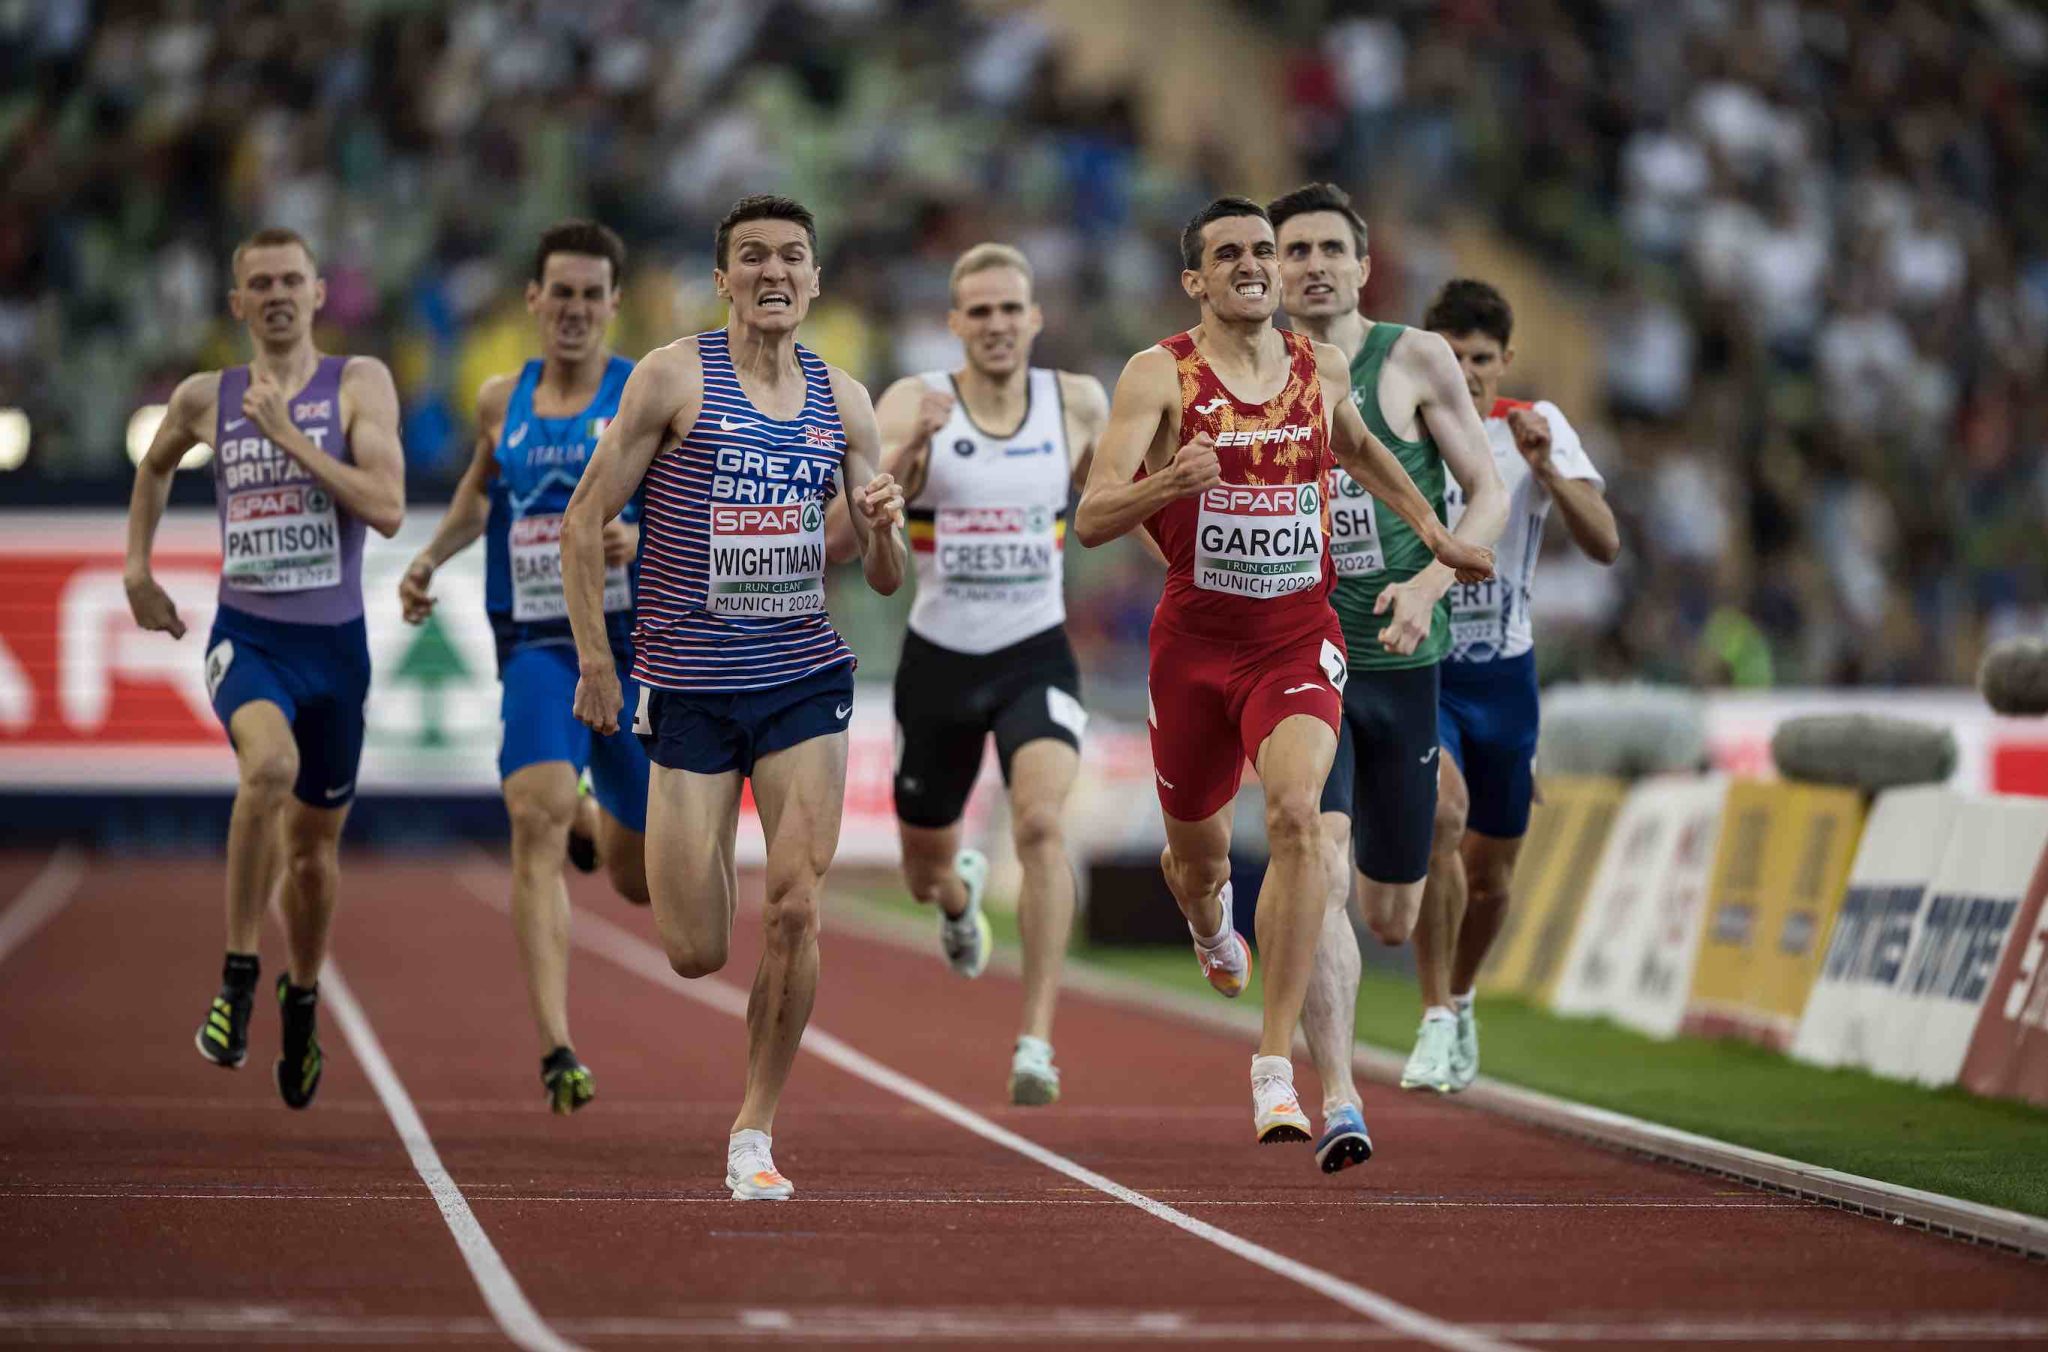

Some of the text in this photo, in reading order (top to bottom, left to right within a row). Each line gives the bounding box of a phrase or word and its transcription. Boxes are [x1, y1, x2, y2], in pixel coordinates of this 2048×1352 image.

[222, 427, 329, 464] GRET
[1214, 425, 1312, 447] ESPAÑA
[226, 461, 312, 489] BRITA
[715, 448, 832, 485] GREAT
[231, 489, 302, 520] SPAR
[1206, 488, 1294, 512] SPAR
[514, 519, 563, 541] SPA
[715, 510, 800, 532] SPAR
[1330, 508, 1371, 537] ISH
[229, 524, 334, 557] PATTISON
[1201, 522, 1319, 557] GARCÍA
[713, 544, 821, 576] WIGHTMAN
[942, 543, 1050, 572] CRESTAN
[1233, 562, 1257, 573] RUN
[1261, 564, 1291, 574] CLEAN
[1334, 555, 1375, 572] 2022
[745, 583, 769, 592] RUN
[772, 582, 800, 592] CLEAN
[1203, 571, 1315, 593] MUNICH 2022
[1451, 580, 1496, 607] ERT
[715, 594, 819, 612] MUNICH 2022
